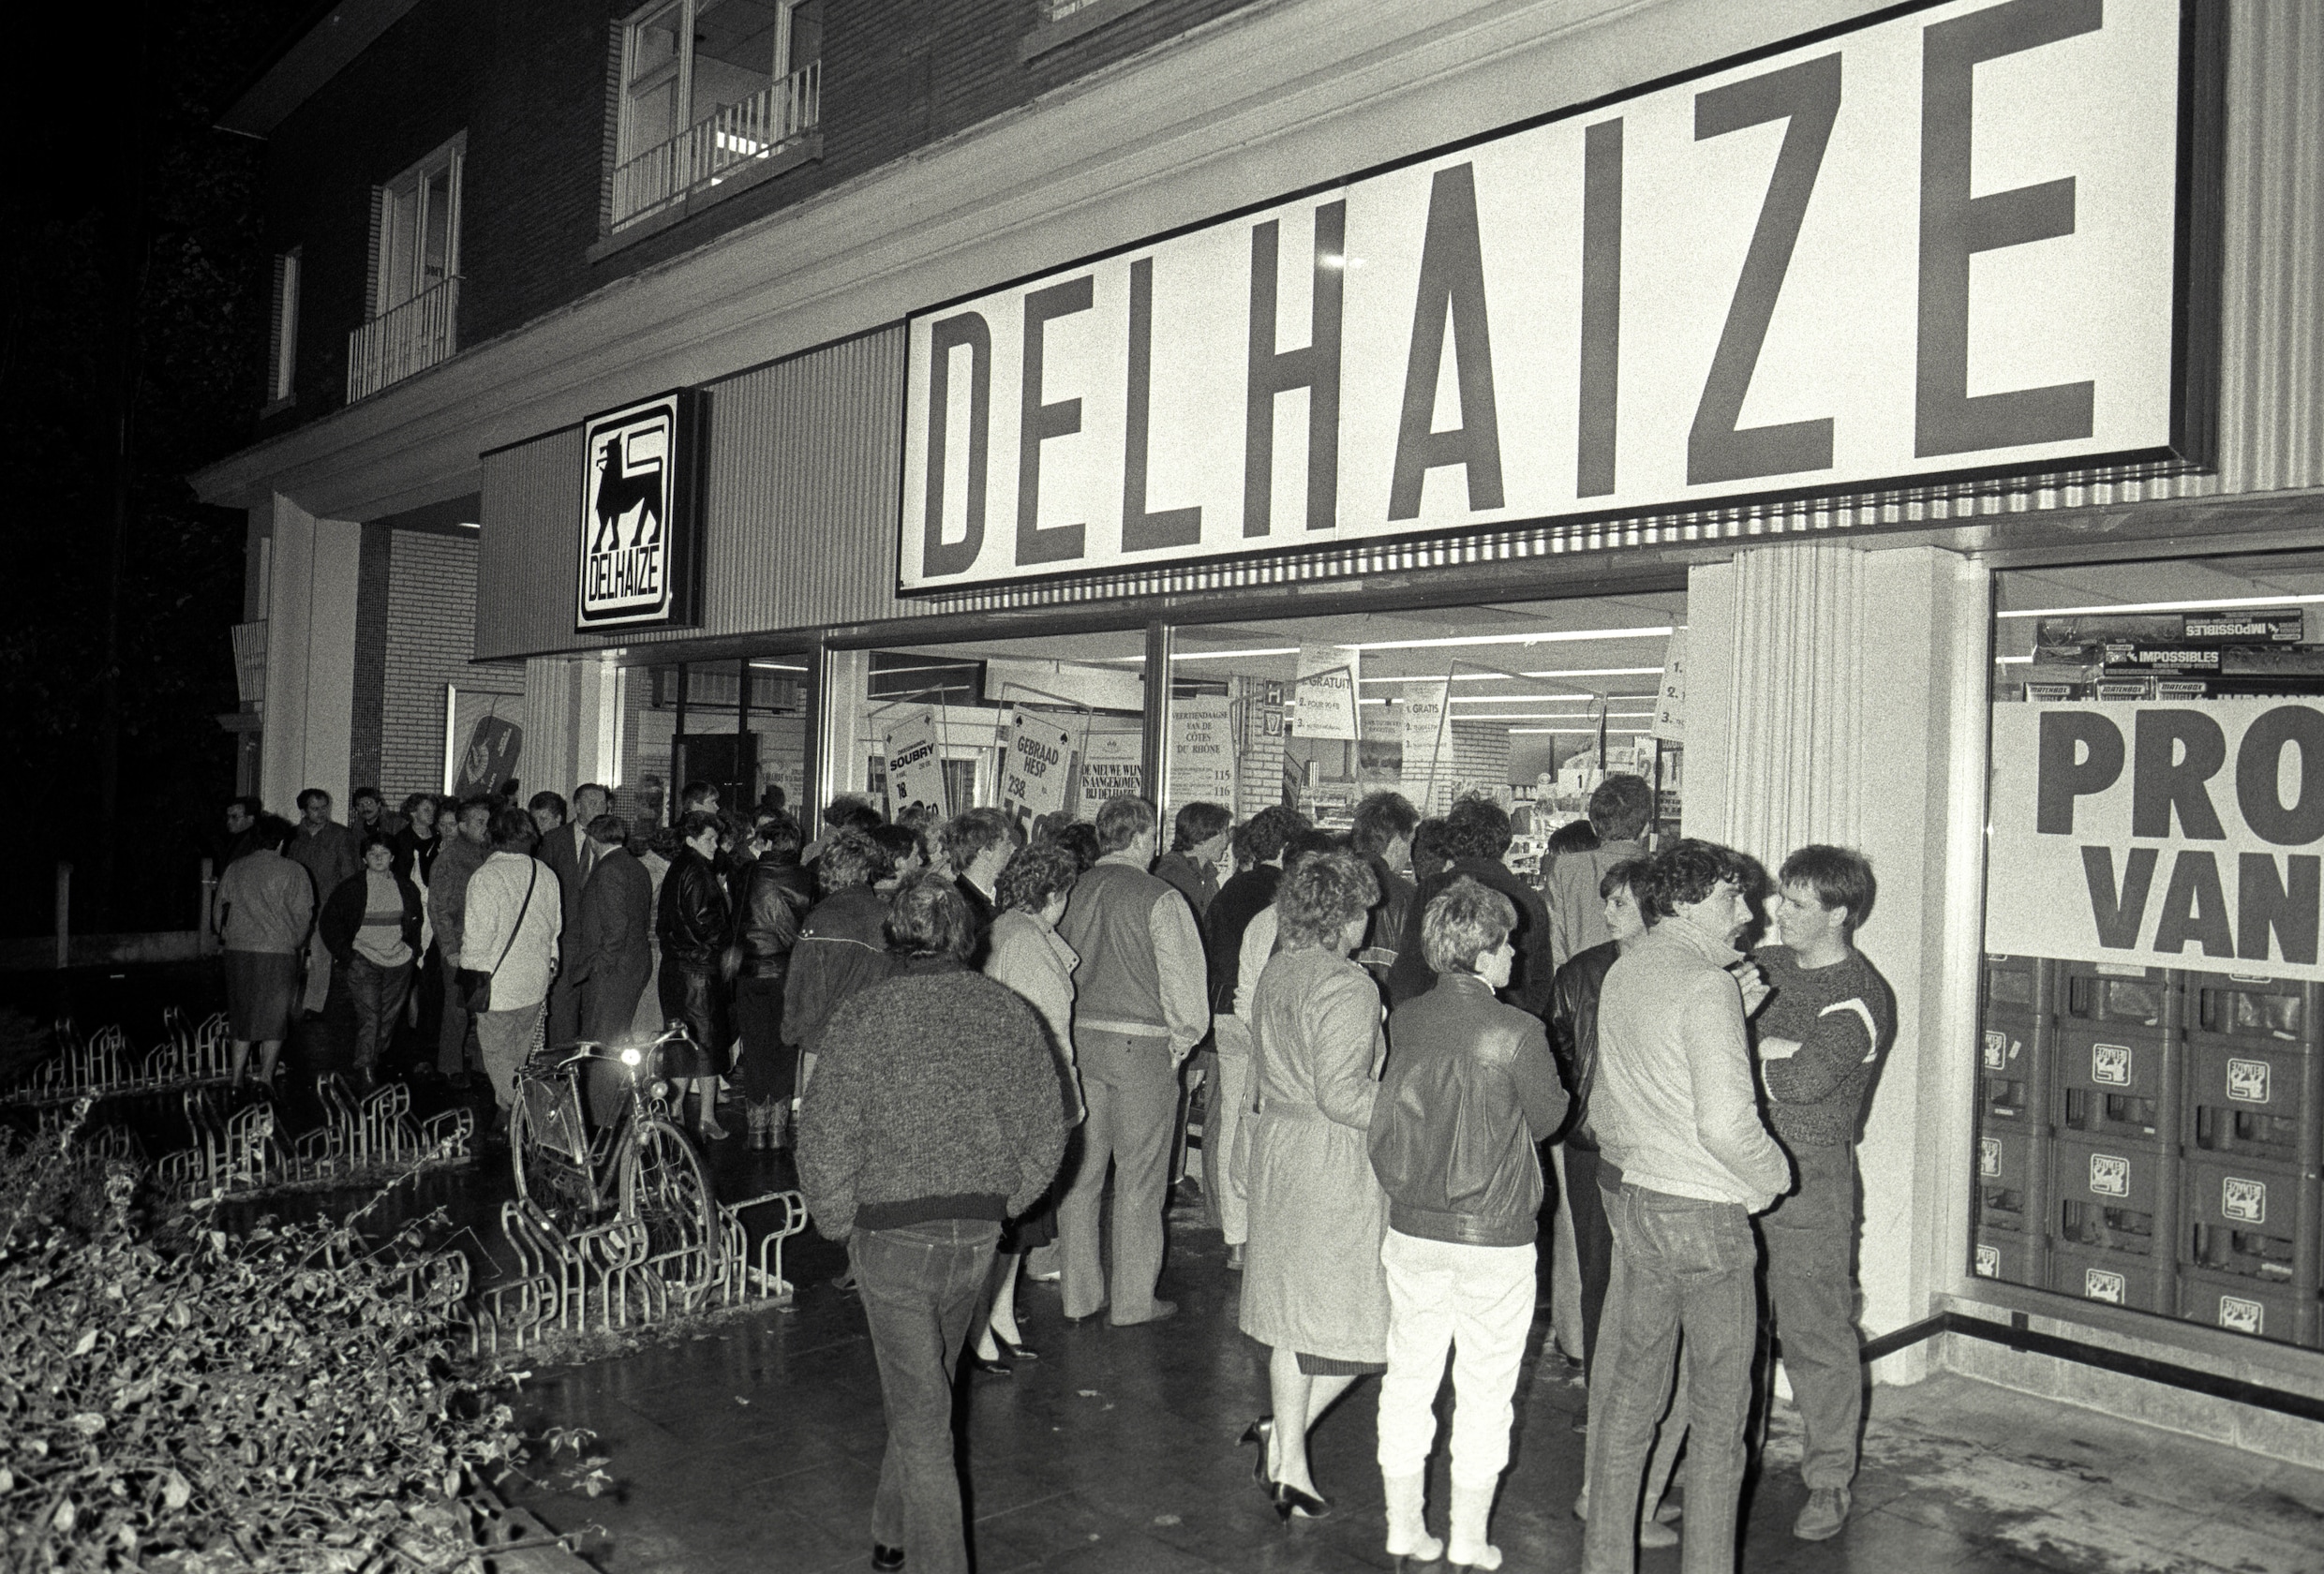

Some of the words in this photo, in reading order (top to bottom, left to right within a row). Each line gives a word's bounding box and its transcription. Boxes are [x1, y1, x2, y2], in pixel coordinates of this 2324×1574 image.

[921, 0, 2102, 580] DELHAIZE
[588, 543, 660, 602] DELHAIZE
[2185, 622, 2266, 636] IMPOSSIBLES
[2138, 650, 2219, 663] IMPOSSIBLES
[1308, 676, 1350, 690] GRATUIT
[2030, 686, 2068, 694] MATCHBOX
[2102, 686, 2142, 694] MATCHBOX
[2161, 683, 2202, 691] MATCHBOX
[1412, 704, 1439, 714] GRATIS
[890, 743, 934, 771] SOUBRY
[1018, 735, 1059, 765] GEBRAAD
[1023, 756, 1047, 779] HESP
[1214, 770, 1230, 780] 115
[2037, 705, 2324, 846] PRO
[1214, 786, 1230, 796] 116
[2080, 845, 2321, 965] VAN
